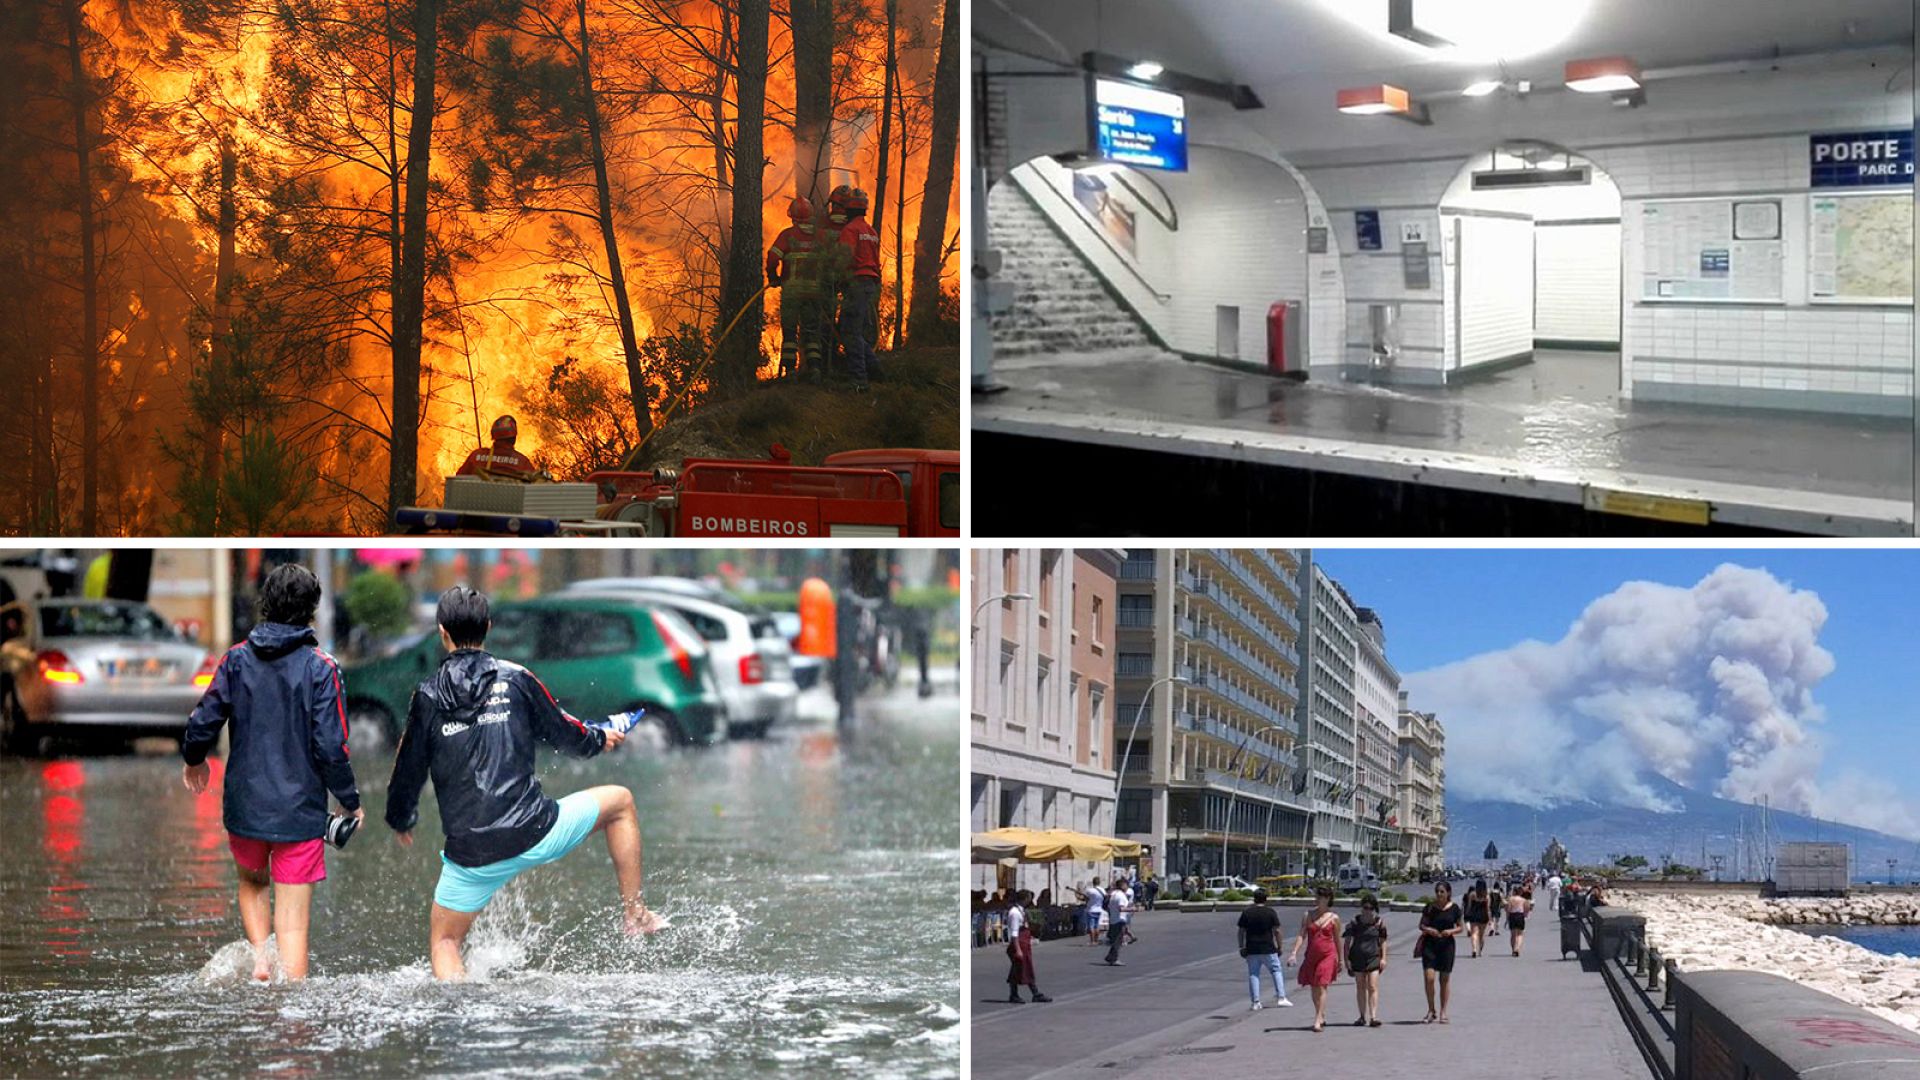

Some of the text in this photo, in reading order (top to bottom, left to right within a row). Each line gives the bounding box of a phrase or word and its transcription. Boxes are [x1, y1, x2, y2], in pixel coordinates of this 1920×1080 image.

[1815, 139, 1899, 162] PORTE
[1858, 164, 1897, 176] PARC
[691, 516, 808, 535] BOMBEIROS
